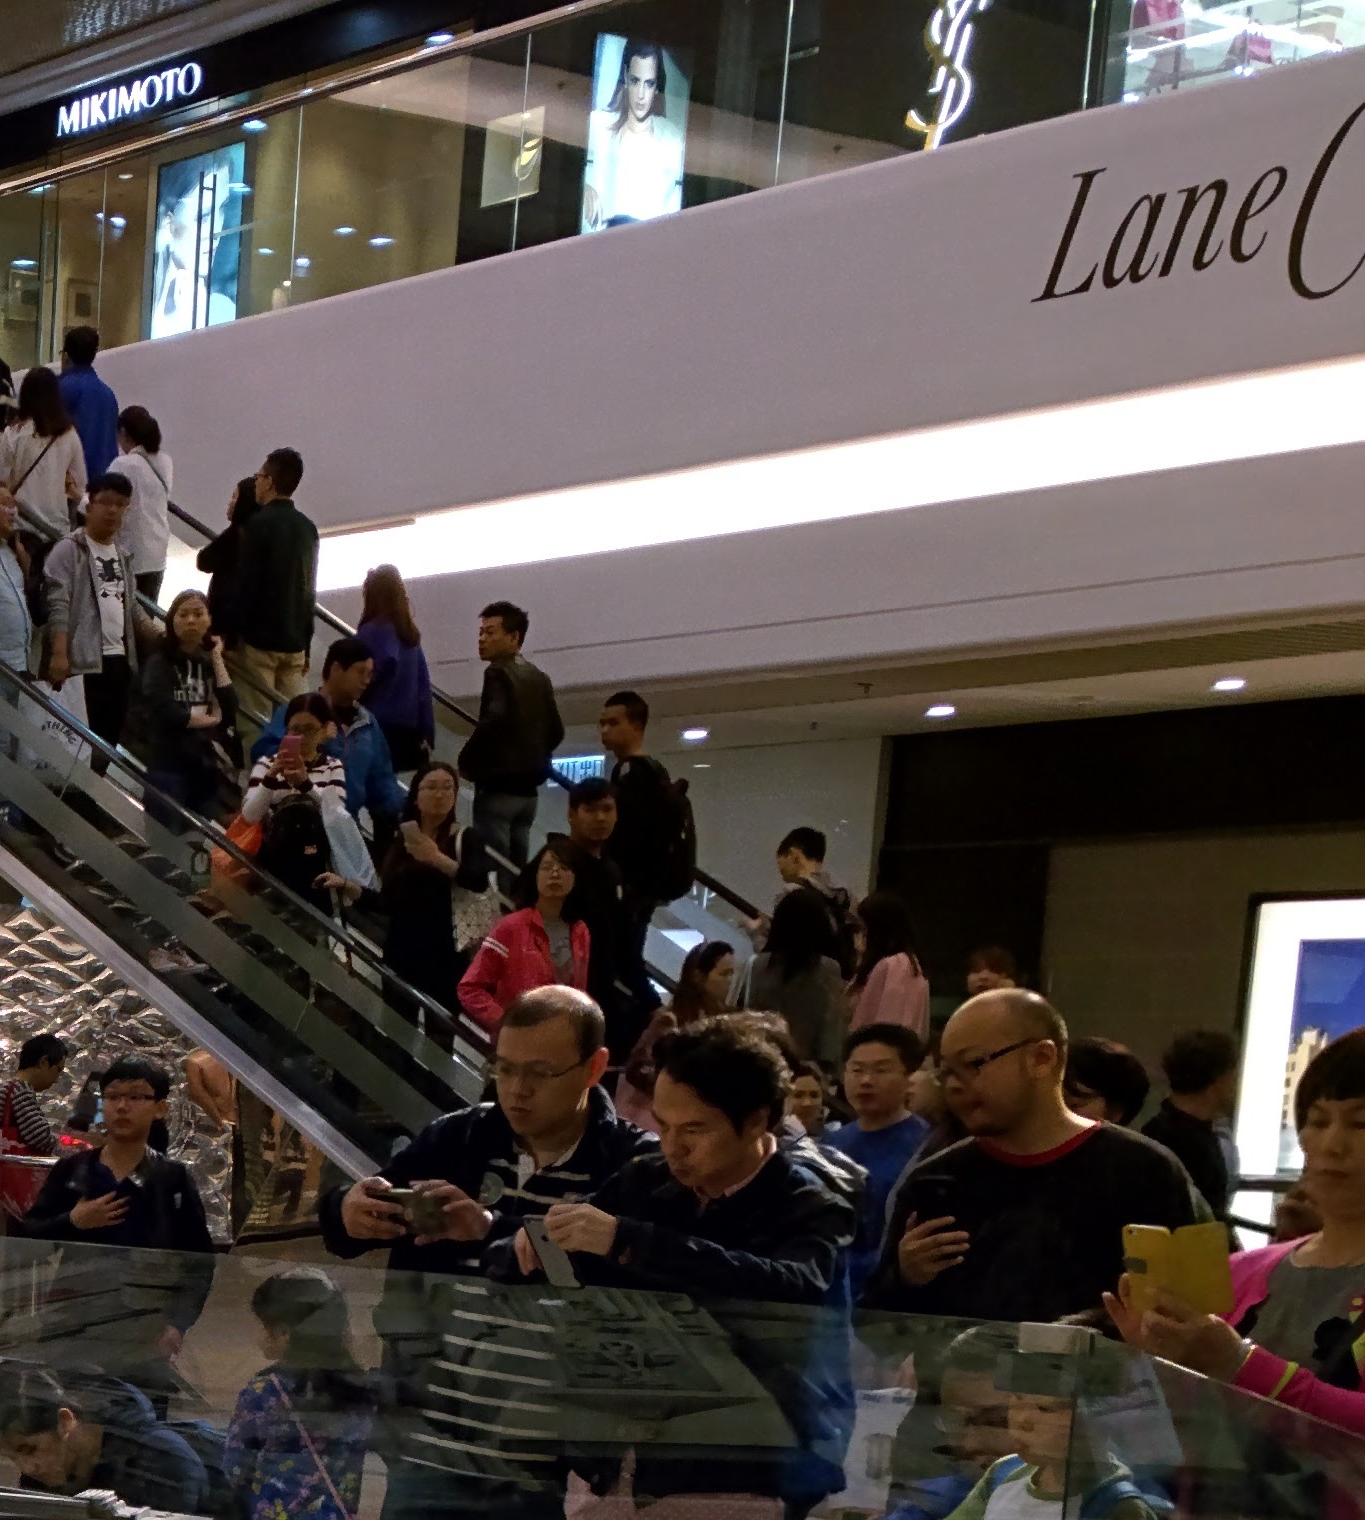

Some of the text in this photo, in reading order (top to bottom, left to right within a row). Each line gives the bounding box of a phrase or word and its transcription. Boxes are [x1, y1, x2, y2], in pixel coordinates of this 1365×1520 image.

[57, 62, 202, 137] MIKIMOTO
[1031, 165, 1287, 303] Lane
[552, 760, 578, 781] XIT
